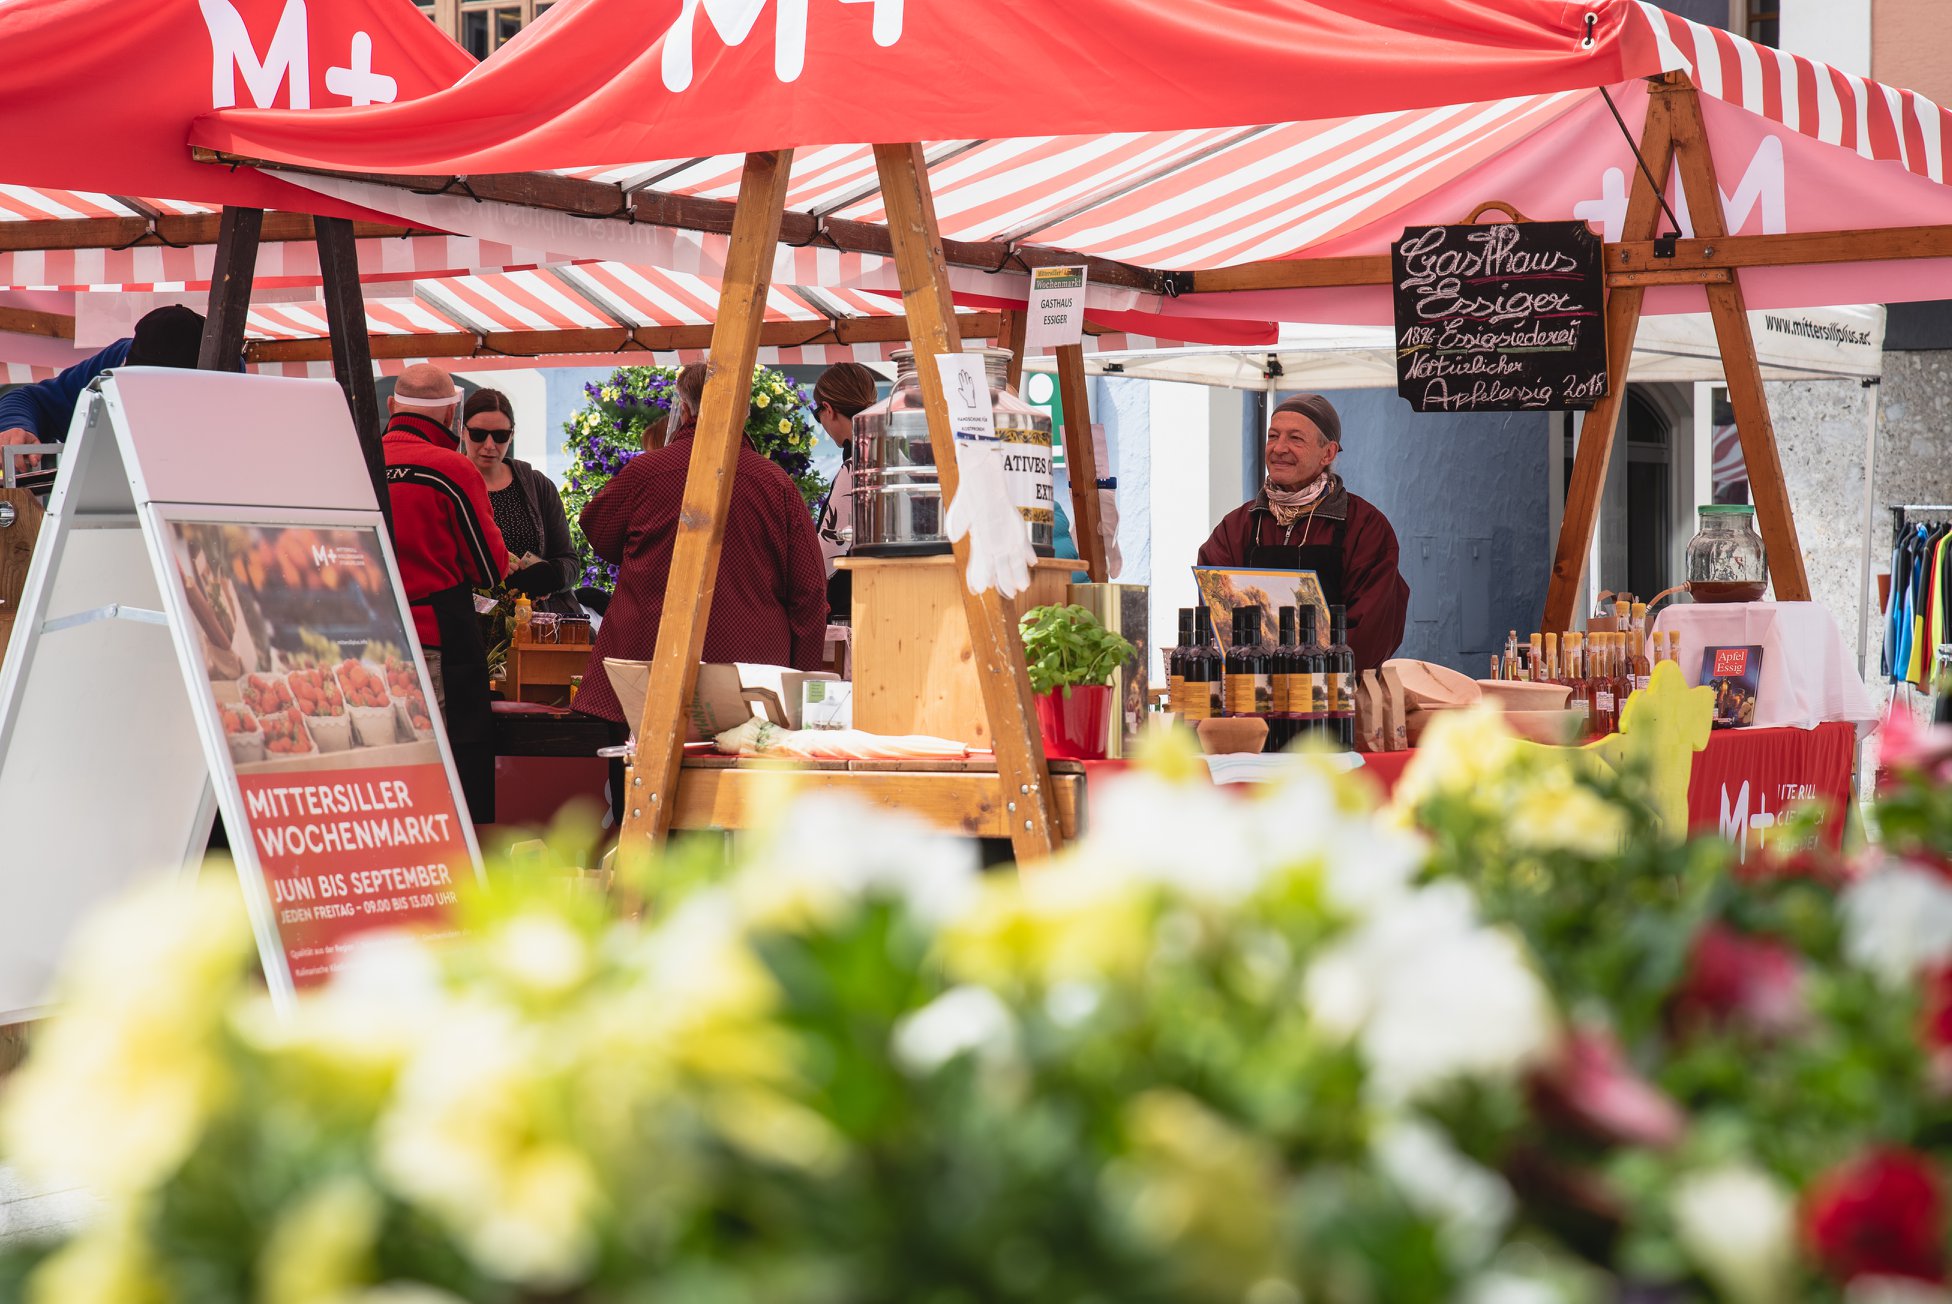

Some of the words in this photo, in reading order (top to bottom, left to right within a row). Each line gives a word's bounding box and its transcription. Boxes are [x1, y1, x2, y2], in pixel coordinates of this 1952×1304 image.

[1400, 224, 1578, 290] Gasthaus
[1036, 278, 1082, 289] Wochenmarkt
[1041, 298, 1072, 308] GASTHAUS
[1416, 277, 1585, 324] Essiger
[1044, 315, 1067, 325] ESSIGER
[1562, 371, 1607, 398] 2018
[1003, 454, 1047, 474] ATIVES
[1717, 662, 1743, 675] Essig
[1719, 651, 1745, 664] Apfel
[246, 780, 413, 819] MITTERSILLER
[257, 813, 450, 858] WOCHENMARKT
[273, 876, 316, 903] JUNI
[319, 873, 348, 898] BIS
[351, 863, 452, 895] SEPTEMBER
[281, 905, 312, 924] JEDEN
[313, 902, 355, 921] FREITAG
[363, 900, 391, 914] 09.00
[392, 897, 408, 911] BIS
[409, 893, 435, 909] 13.00
[437, 891, 458, 905] UHR
